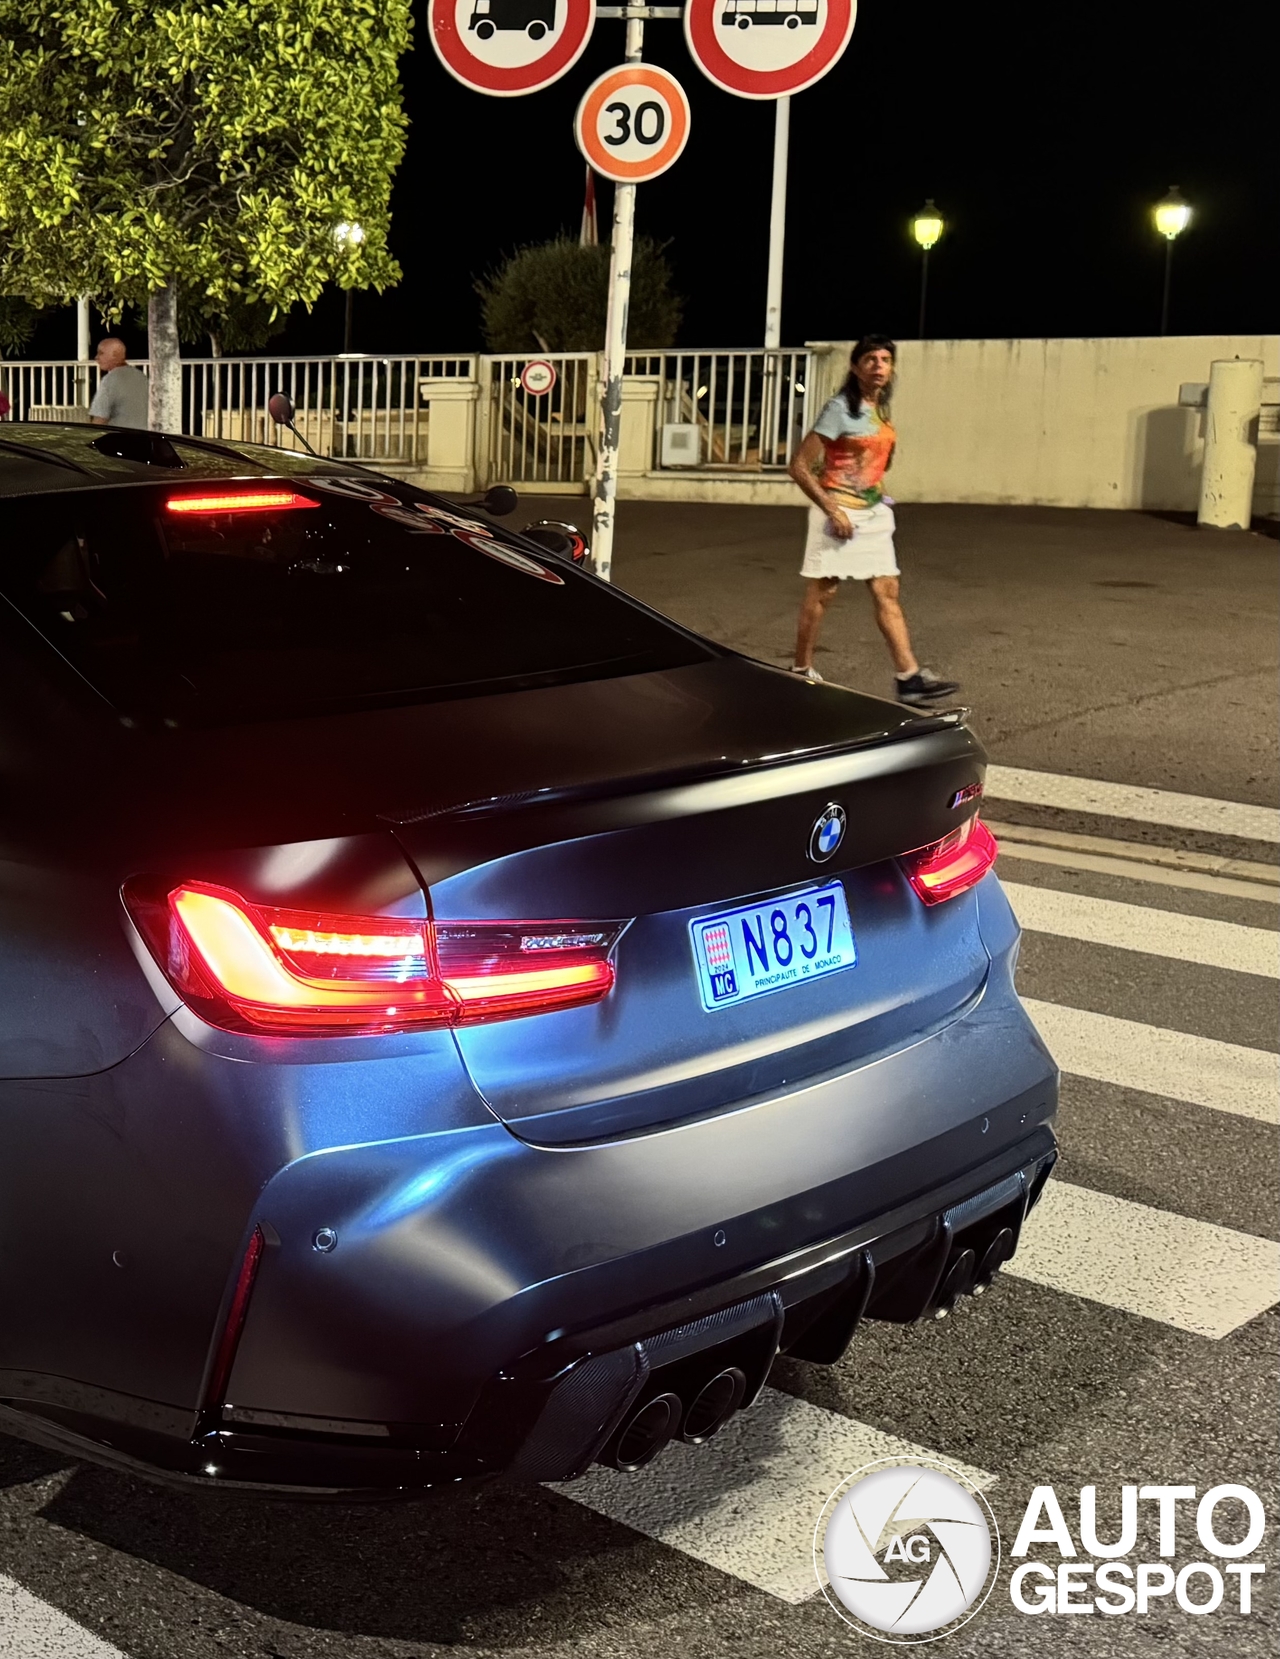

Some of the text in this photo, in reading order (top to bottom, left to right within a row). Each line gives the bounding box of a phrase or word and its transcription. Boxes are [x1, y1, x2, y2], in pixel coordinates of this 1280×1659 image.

[603, 100, 665, 146] 30
[740, 894, 836, 977] N837
[713, 964, 730, 974] 2024
[714, 974, 734, 996] MC
[754, 954, 842, 989] PRINCIPAUTE DE MONACO
